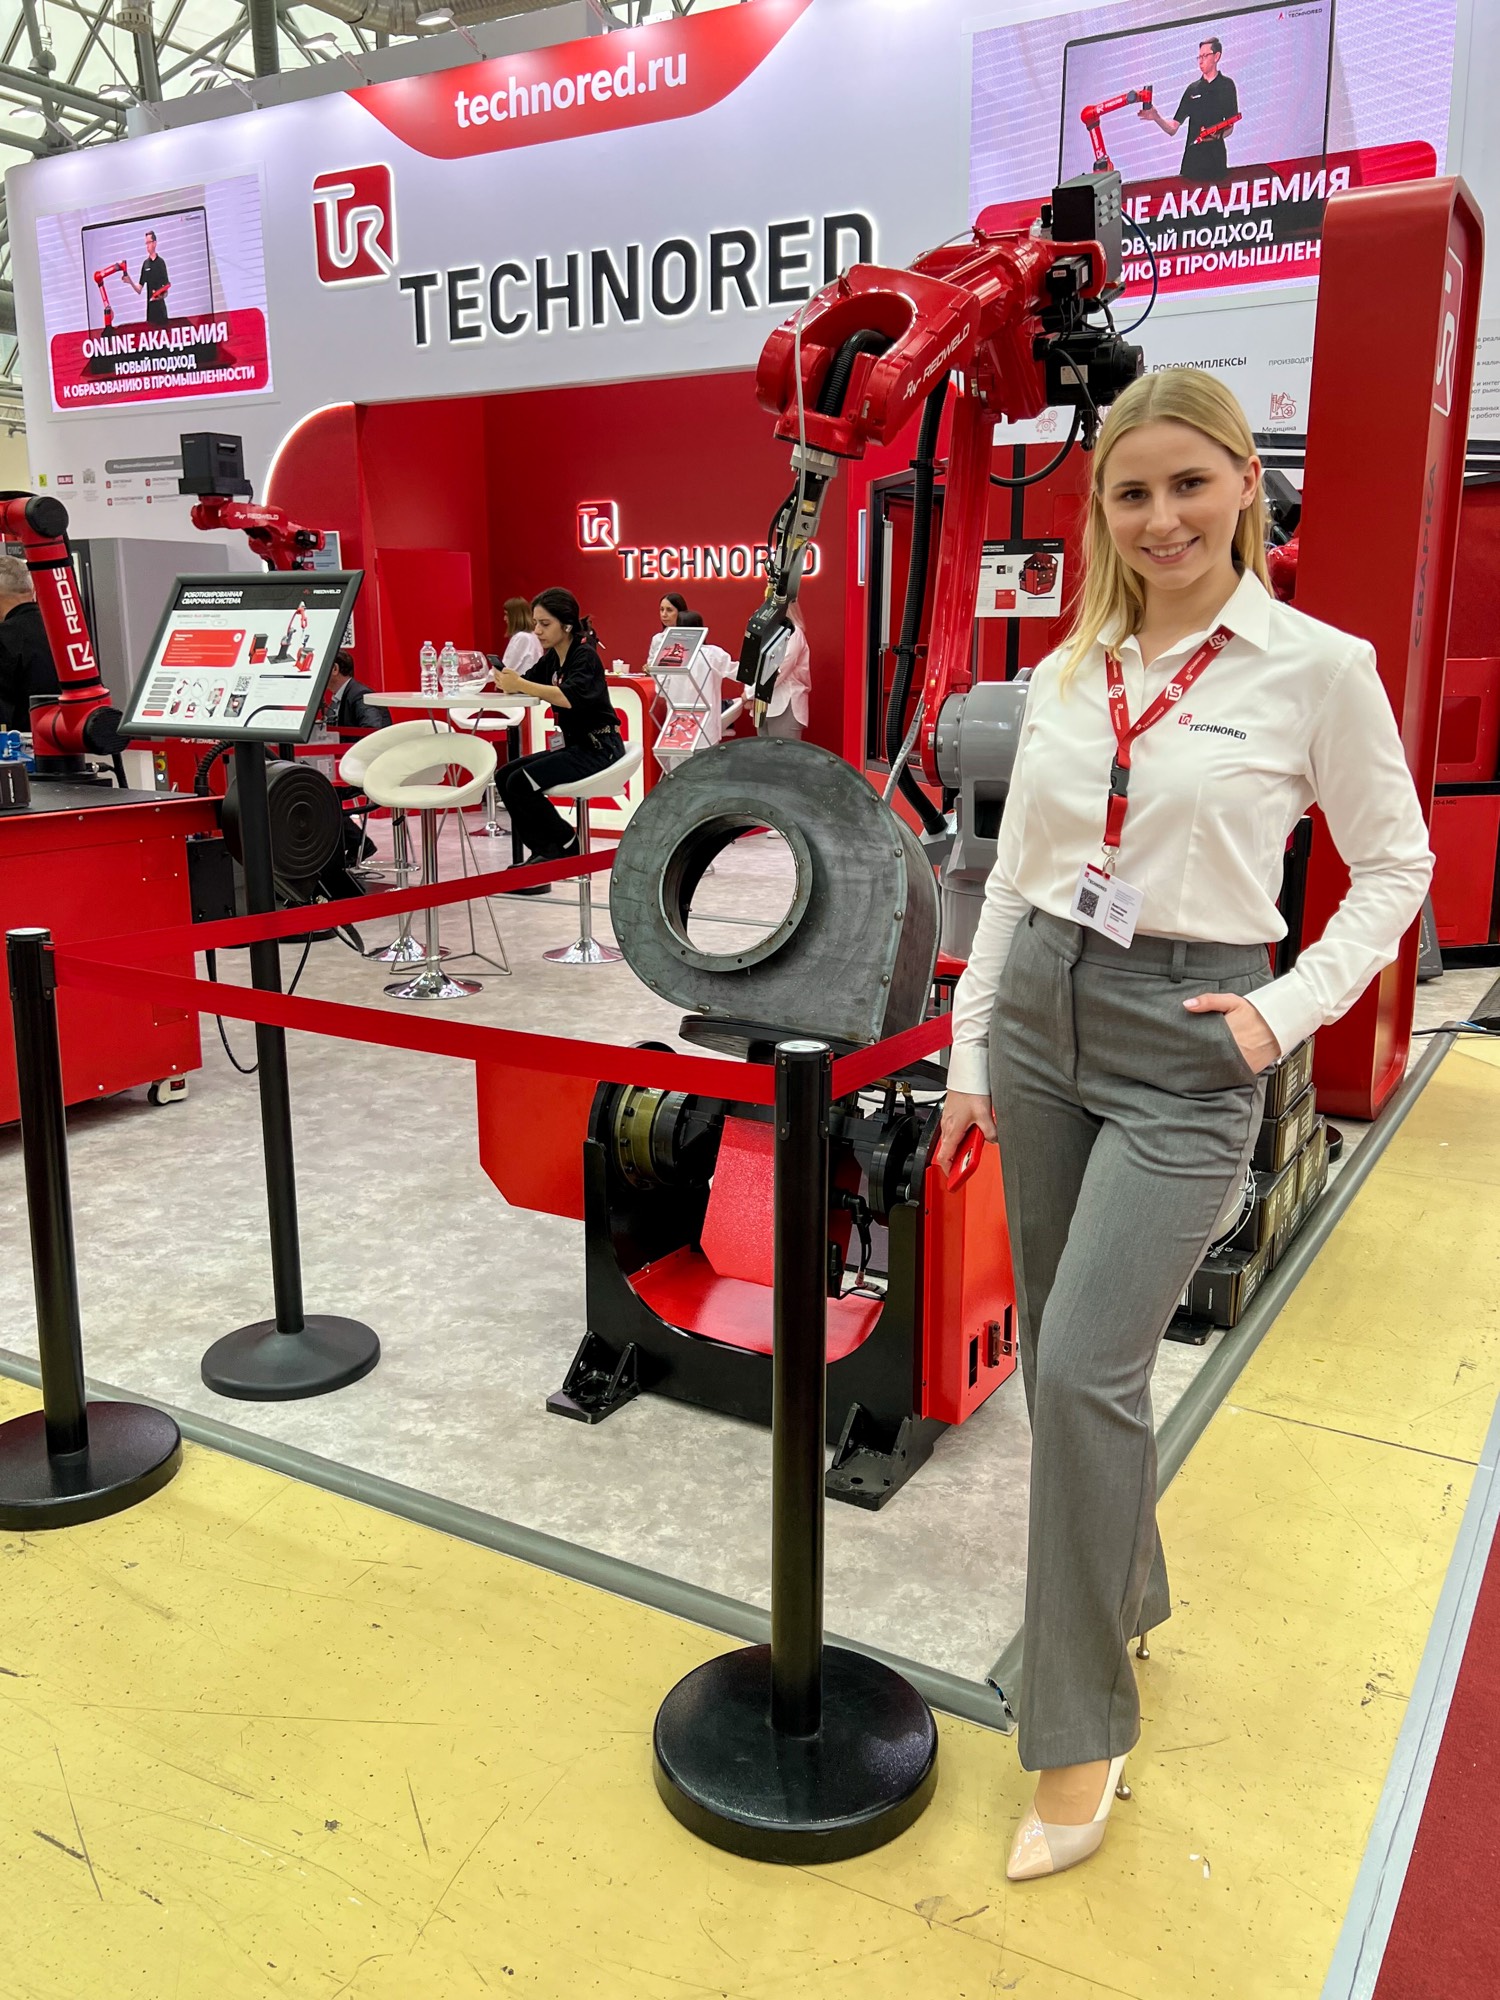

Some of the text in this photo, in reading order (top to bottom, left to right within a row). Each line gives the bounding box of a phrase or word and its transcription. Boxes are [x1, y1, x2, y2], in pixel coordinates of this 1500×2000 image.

[454, 51, 688, 129] technored.ru
[1156, 165, 1350, 222] АКАДЕМИЯ
[1181, 219, 1274, 250] ПОДХОД
[1159, 259, 1171, 278] В
[1175, 239, 1321, 276] ПРОМЫШЛЕН
[400, 212, 876, 346] TECHNORED
[82, 321, 228, 359] ONLINE АКАДЕМИЯ
[922, 322, 970, 383] REDWELD
[63, 364, 255, 399] К ОБРАЗОВАНИЮ В ПРОМЫШЛЕННОСТИ
[114, 354, 197, 376] НОВЫЙ ПОДХОД
[1261, 425, 1297, 433] Медицина
[617, 541, 821, 580] TECHNORD
[1414, 461, 1437, 648] СВАРКА
[1189, 723, 1248, 741] TECHNORED
